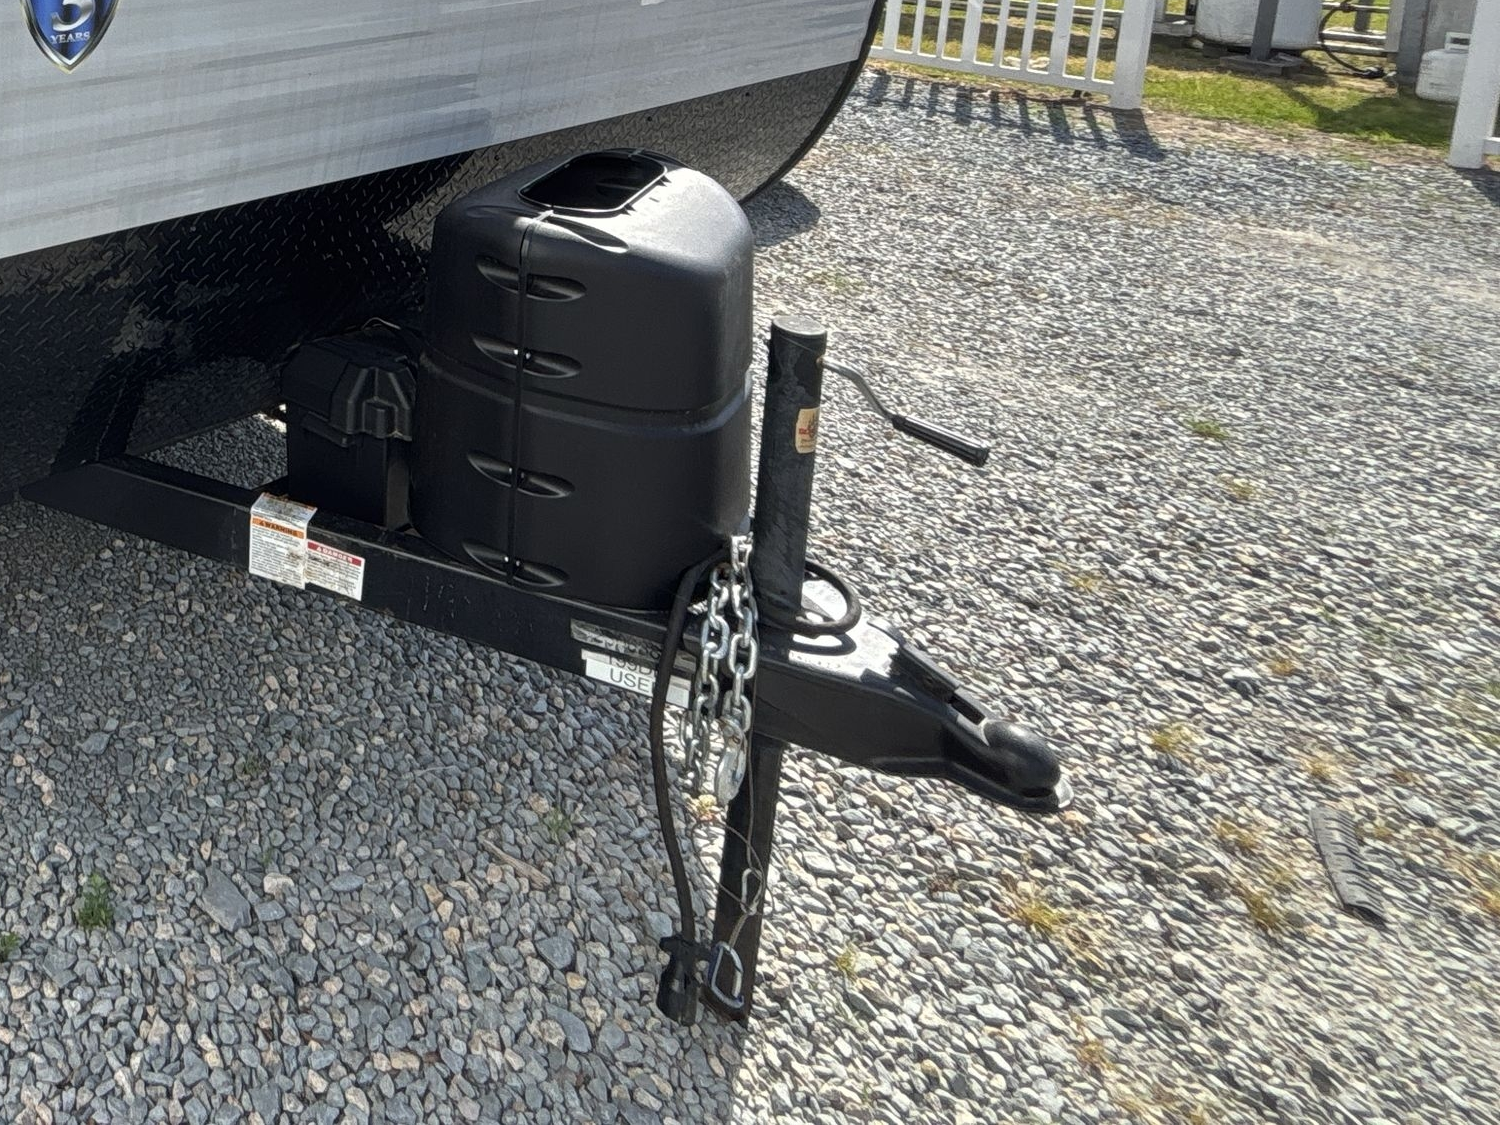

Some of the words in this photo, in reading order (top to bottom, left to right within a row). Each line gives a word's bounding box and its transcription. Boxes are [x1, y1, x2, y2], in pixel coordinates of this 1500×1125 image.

[50, 31, 91, 44] YEARS
[265, 521, 298, 536] WARNING
[322, 547, 353, 563] DANGER
[610, 668, 656, 693] USE
